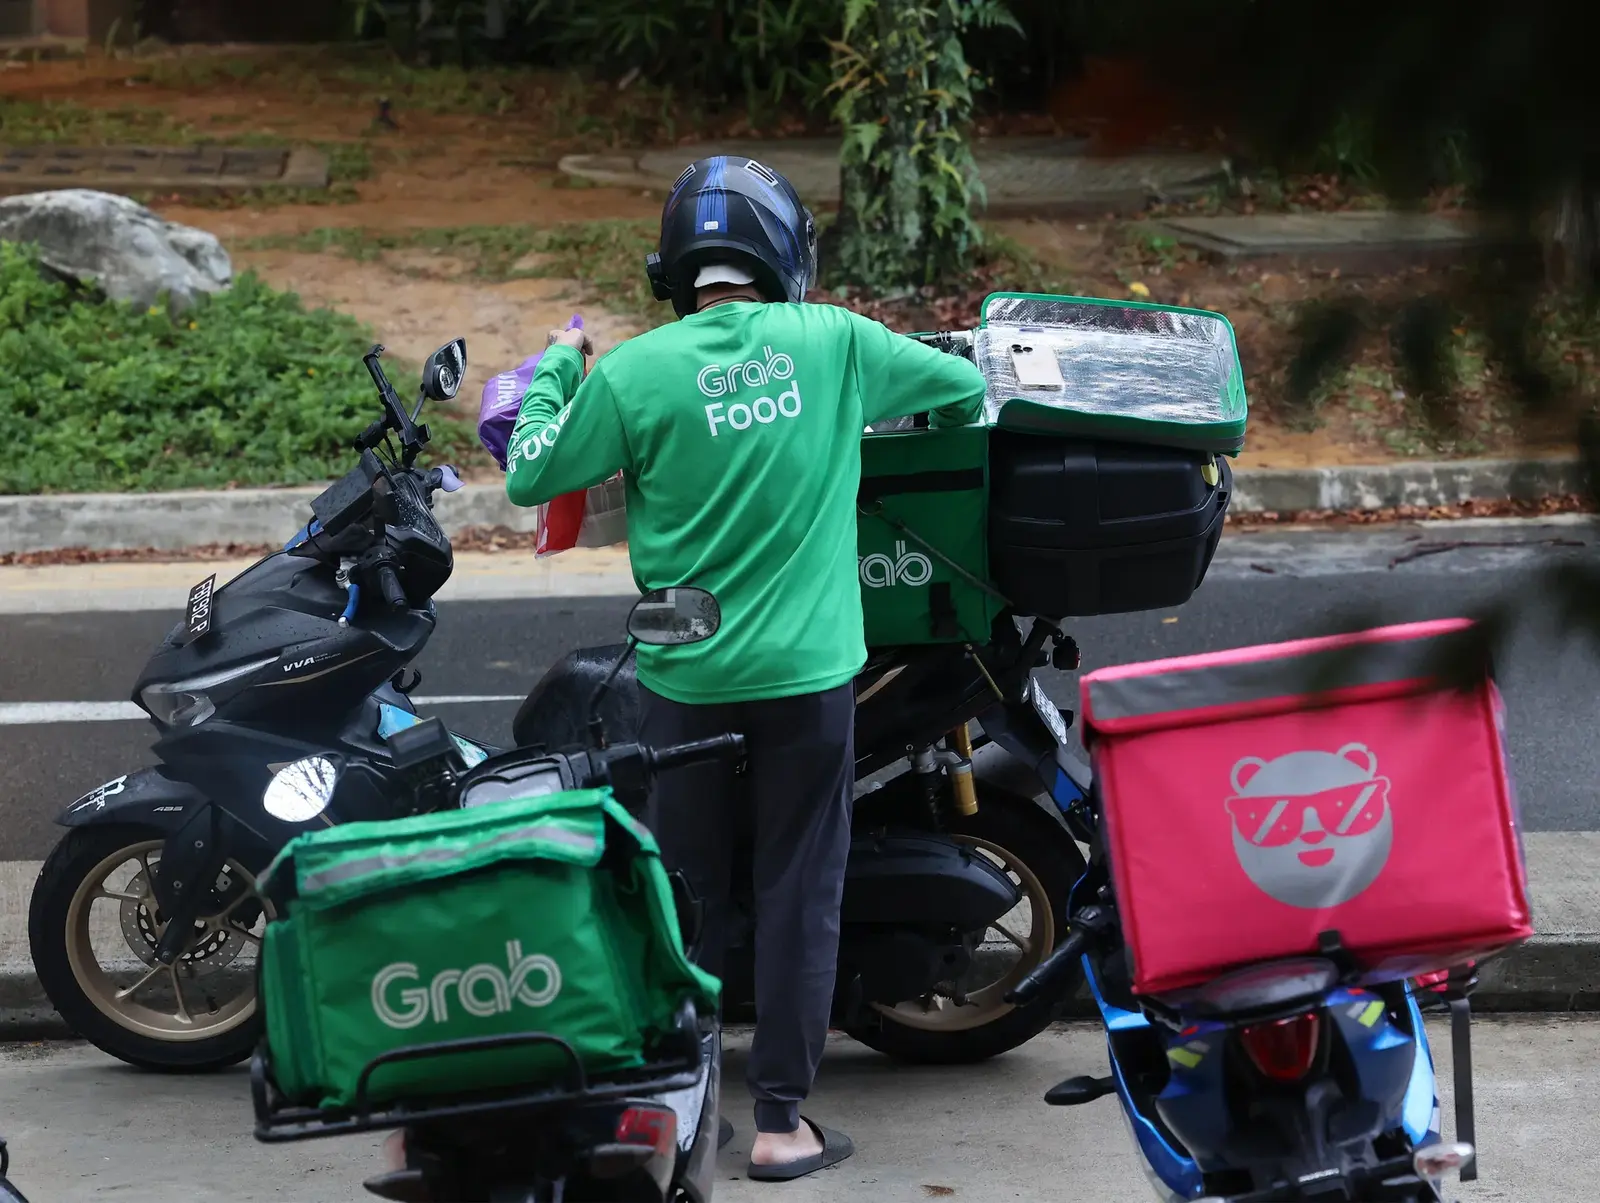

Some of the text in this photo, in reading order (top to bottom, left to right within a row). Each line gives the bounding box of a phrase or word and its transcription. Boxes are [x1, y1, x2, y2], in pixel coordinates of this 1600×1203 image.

[697, 345, 795, 399] Grab
[704, 380, 804, 437] Food
[283, 656, 316, 672] VVA
[371, 939, 562, 1029] Grab
